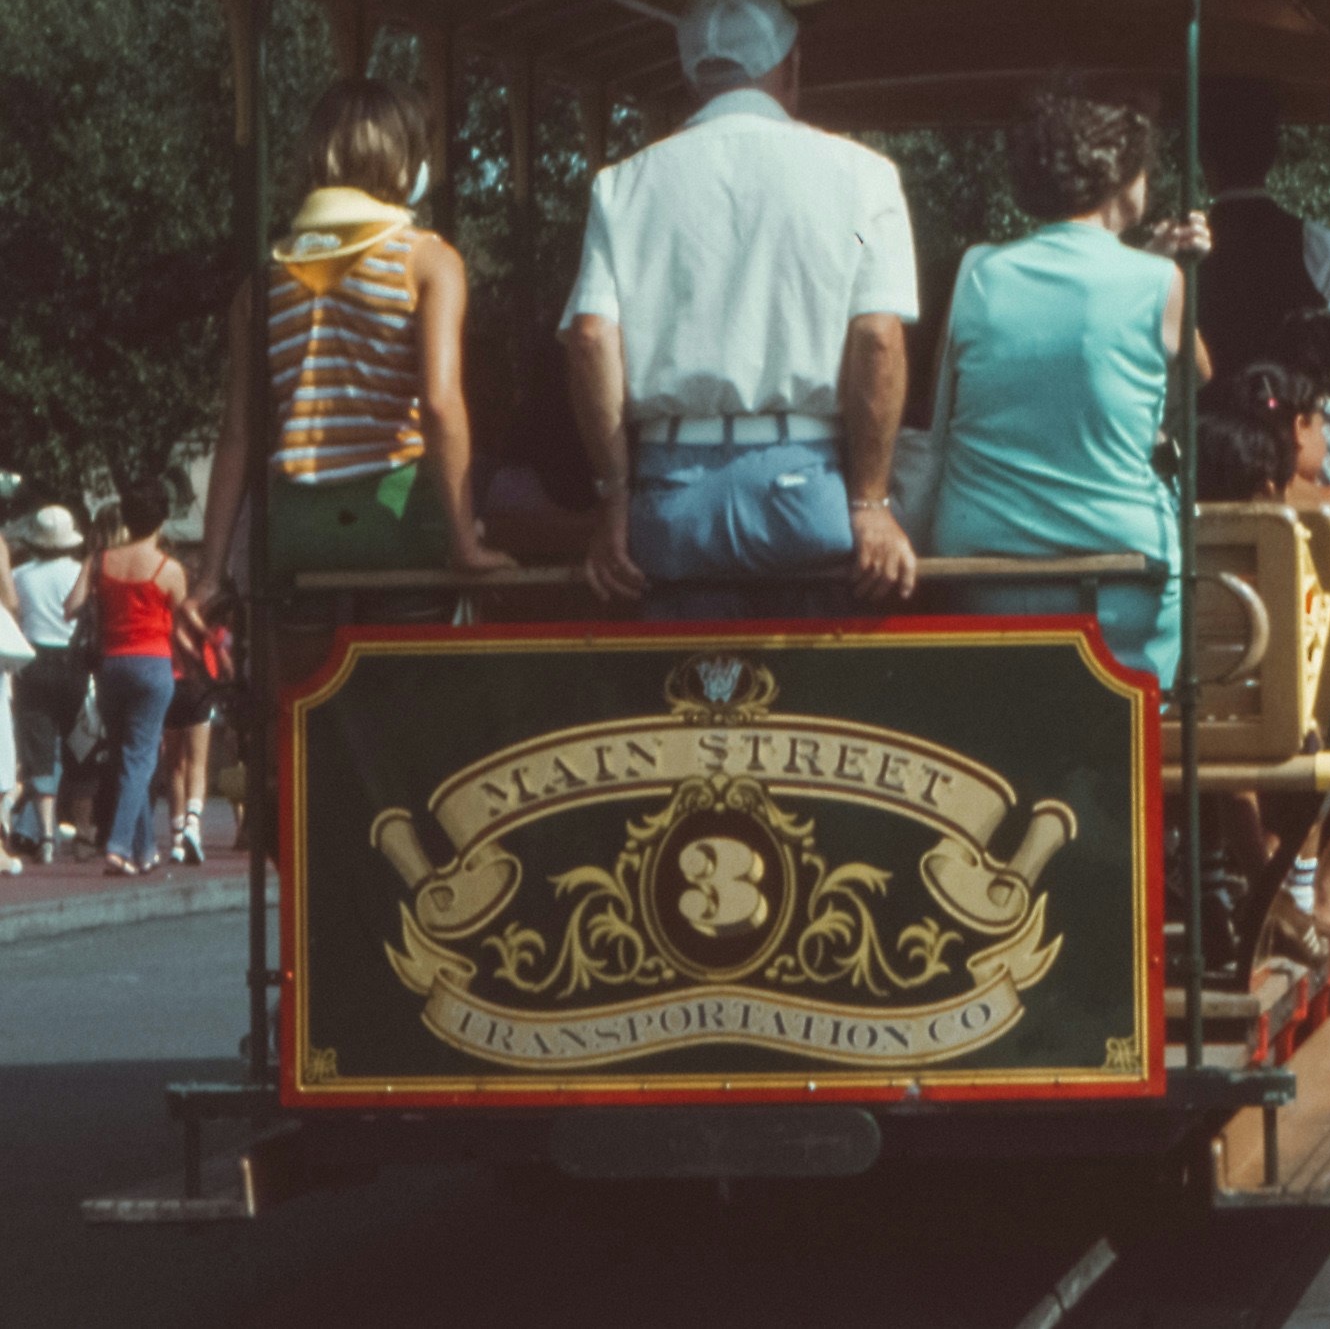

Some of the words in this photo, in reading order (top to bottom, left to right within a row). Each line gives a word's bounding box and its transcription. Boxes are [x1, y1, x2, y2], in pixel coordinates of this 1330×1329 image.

[479, 738, 664, 818] MAIN
[697, 733, 953, 807] STREET
[679, 837, 768, 934] 3
[451, 1000, 916, 1055] TRANSPORTATION
